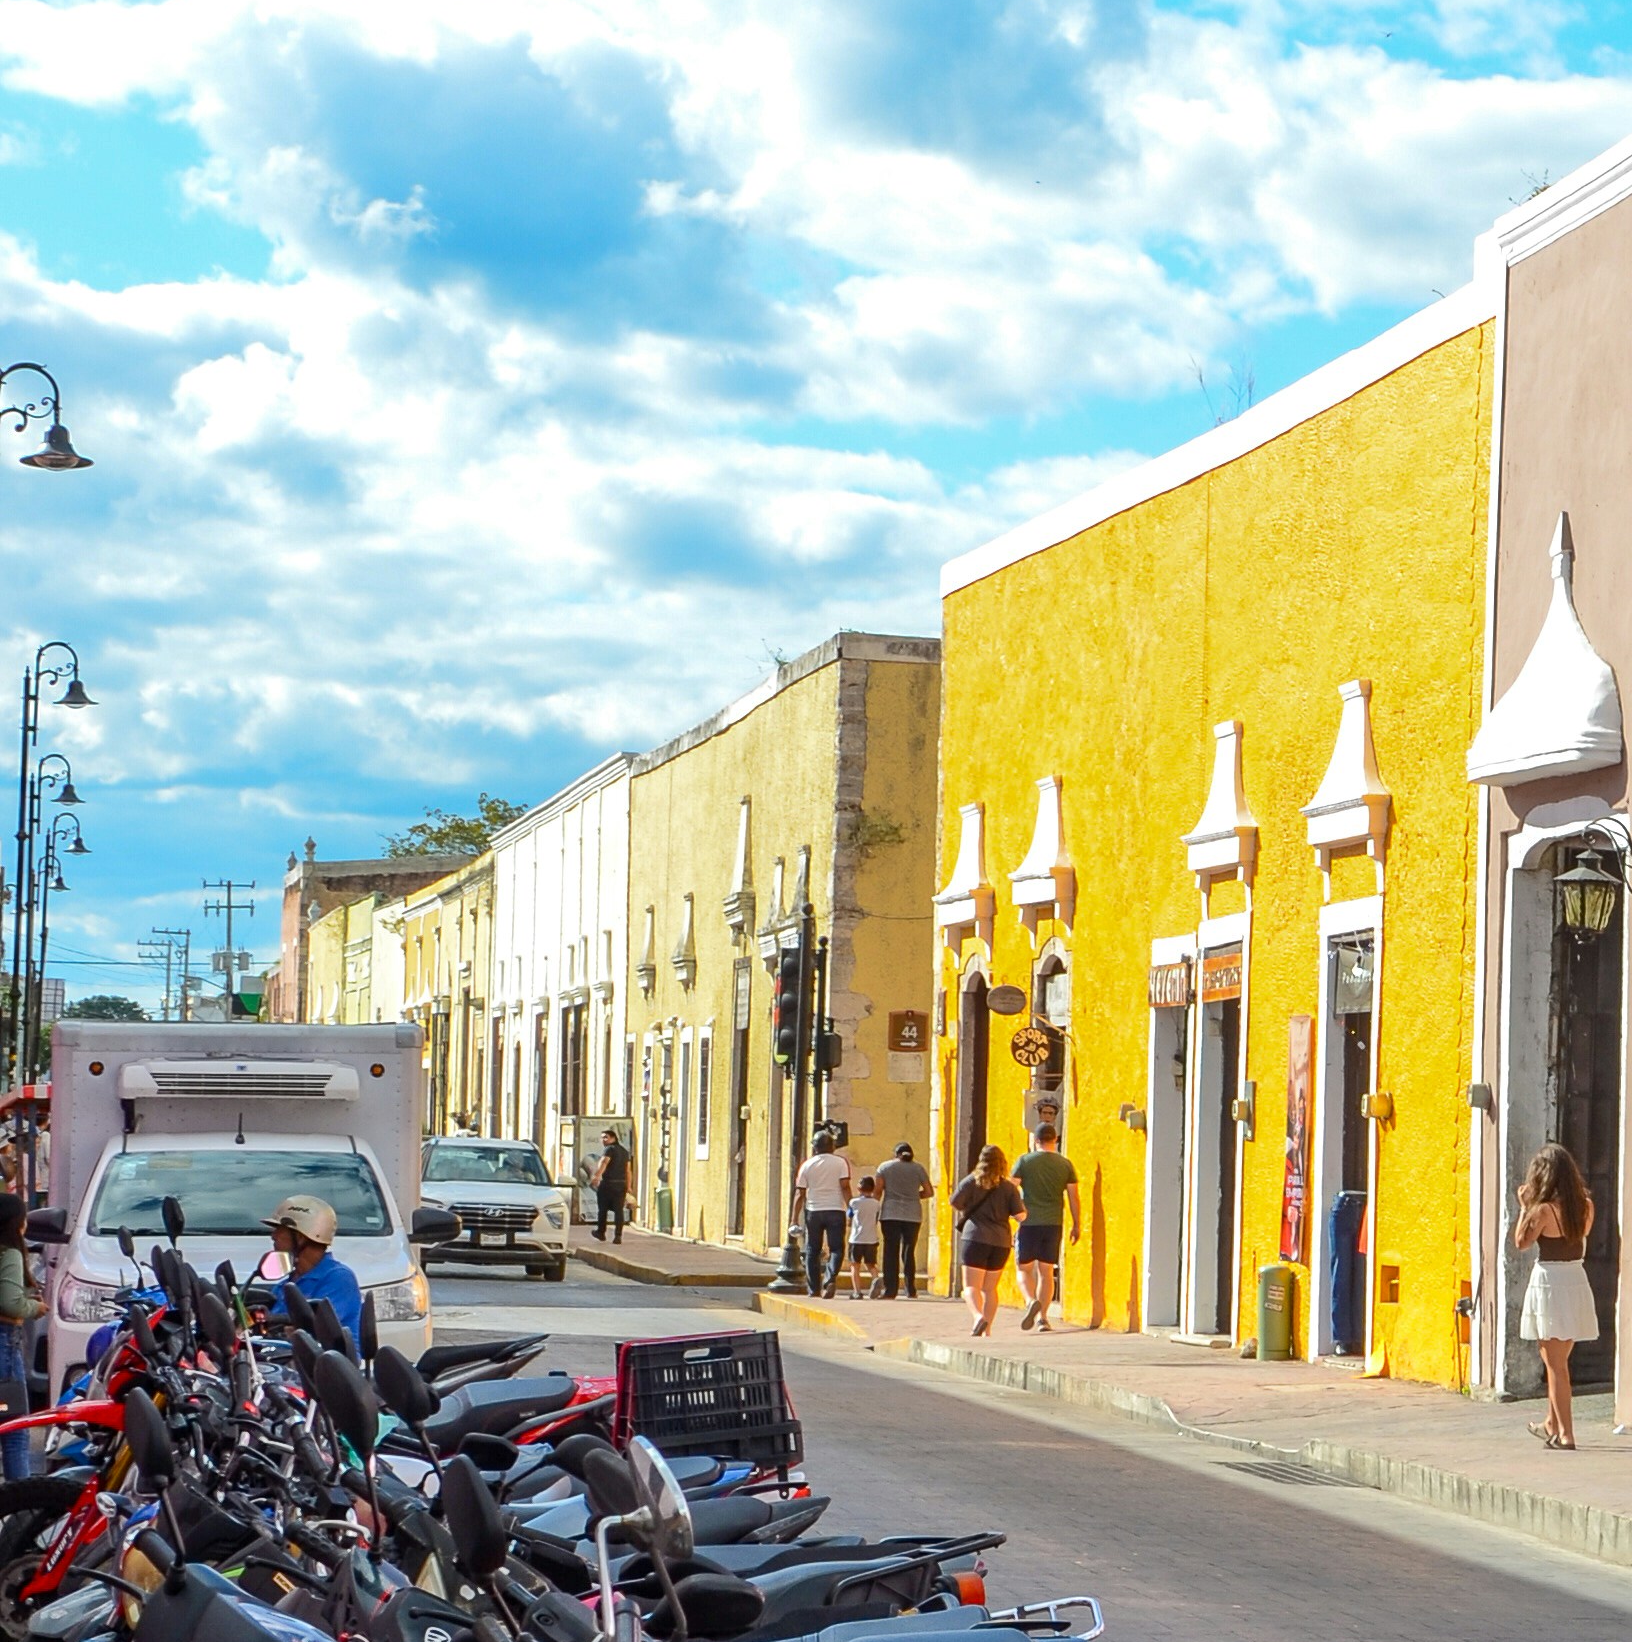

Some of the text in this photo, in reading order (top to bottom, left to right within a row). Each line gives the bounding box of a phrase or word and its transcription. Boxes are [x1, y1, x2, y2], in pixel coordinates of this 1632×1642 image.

[901, 1026, 919, 1038] 44
[1013, 1028, 1049, 1047] SPORT
[1015, 1047, 1049, 1066] CLUB
